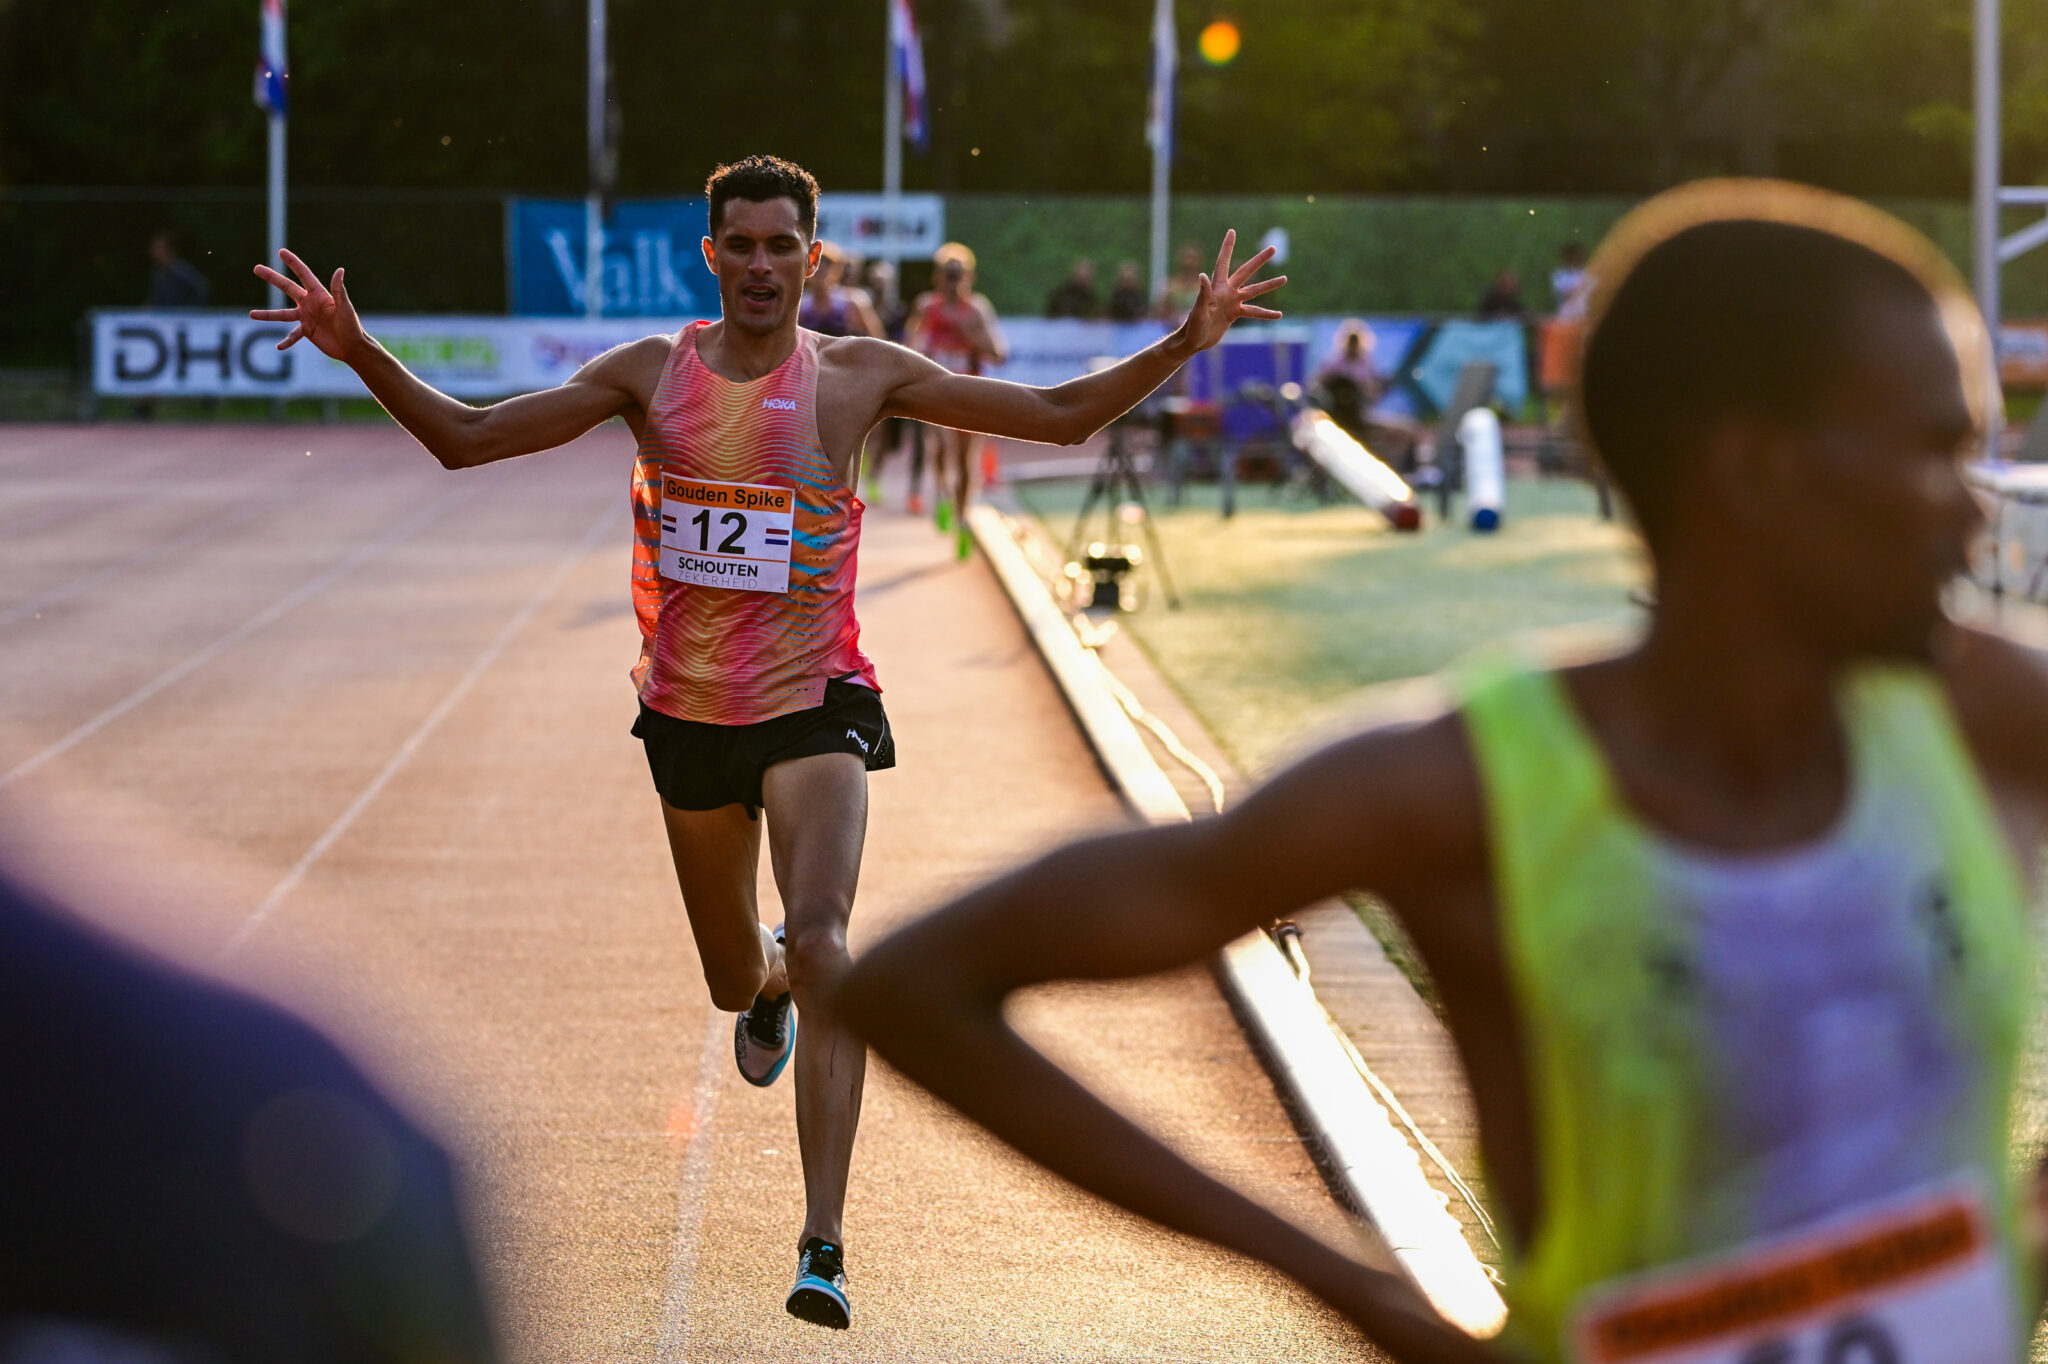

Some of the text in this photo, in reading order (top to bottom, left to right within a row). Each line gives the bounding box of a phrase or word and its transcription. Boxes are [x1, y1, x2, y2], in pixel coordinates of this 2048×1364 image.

[114, 327, 293, 381] DHG
[762, 398, 796, 410] HOKA
[666, 479, 785, 509] Gouden Spike
[691, 508, 748, 555] 12
[678, 556, 759, 578] SCHOUTEN
[678, 570, 758, 590] ZEKERHEID
